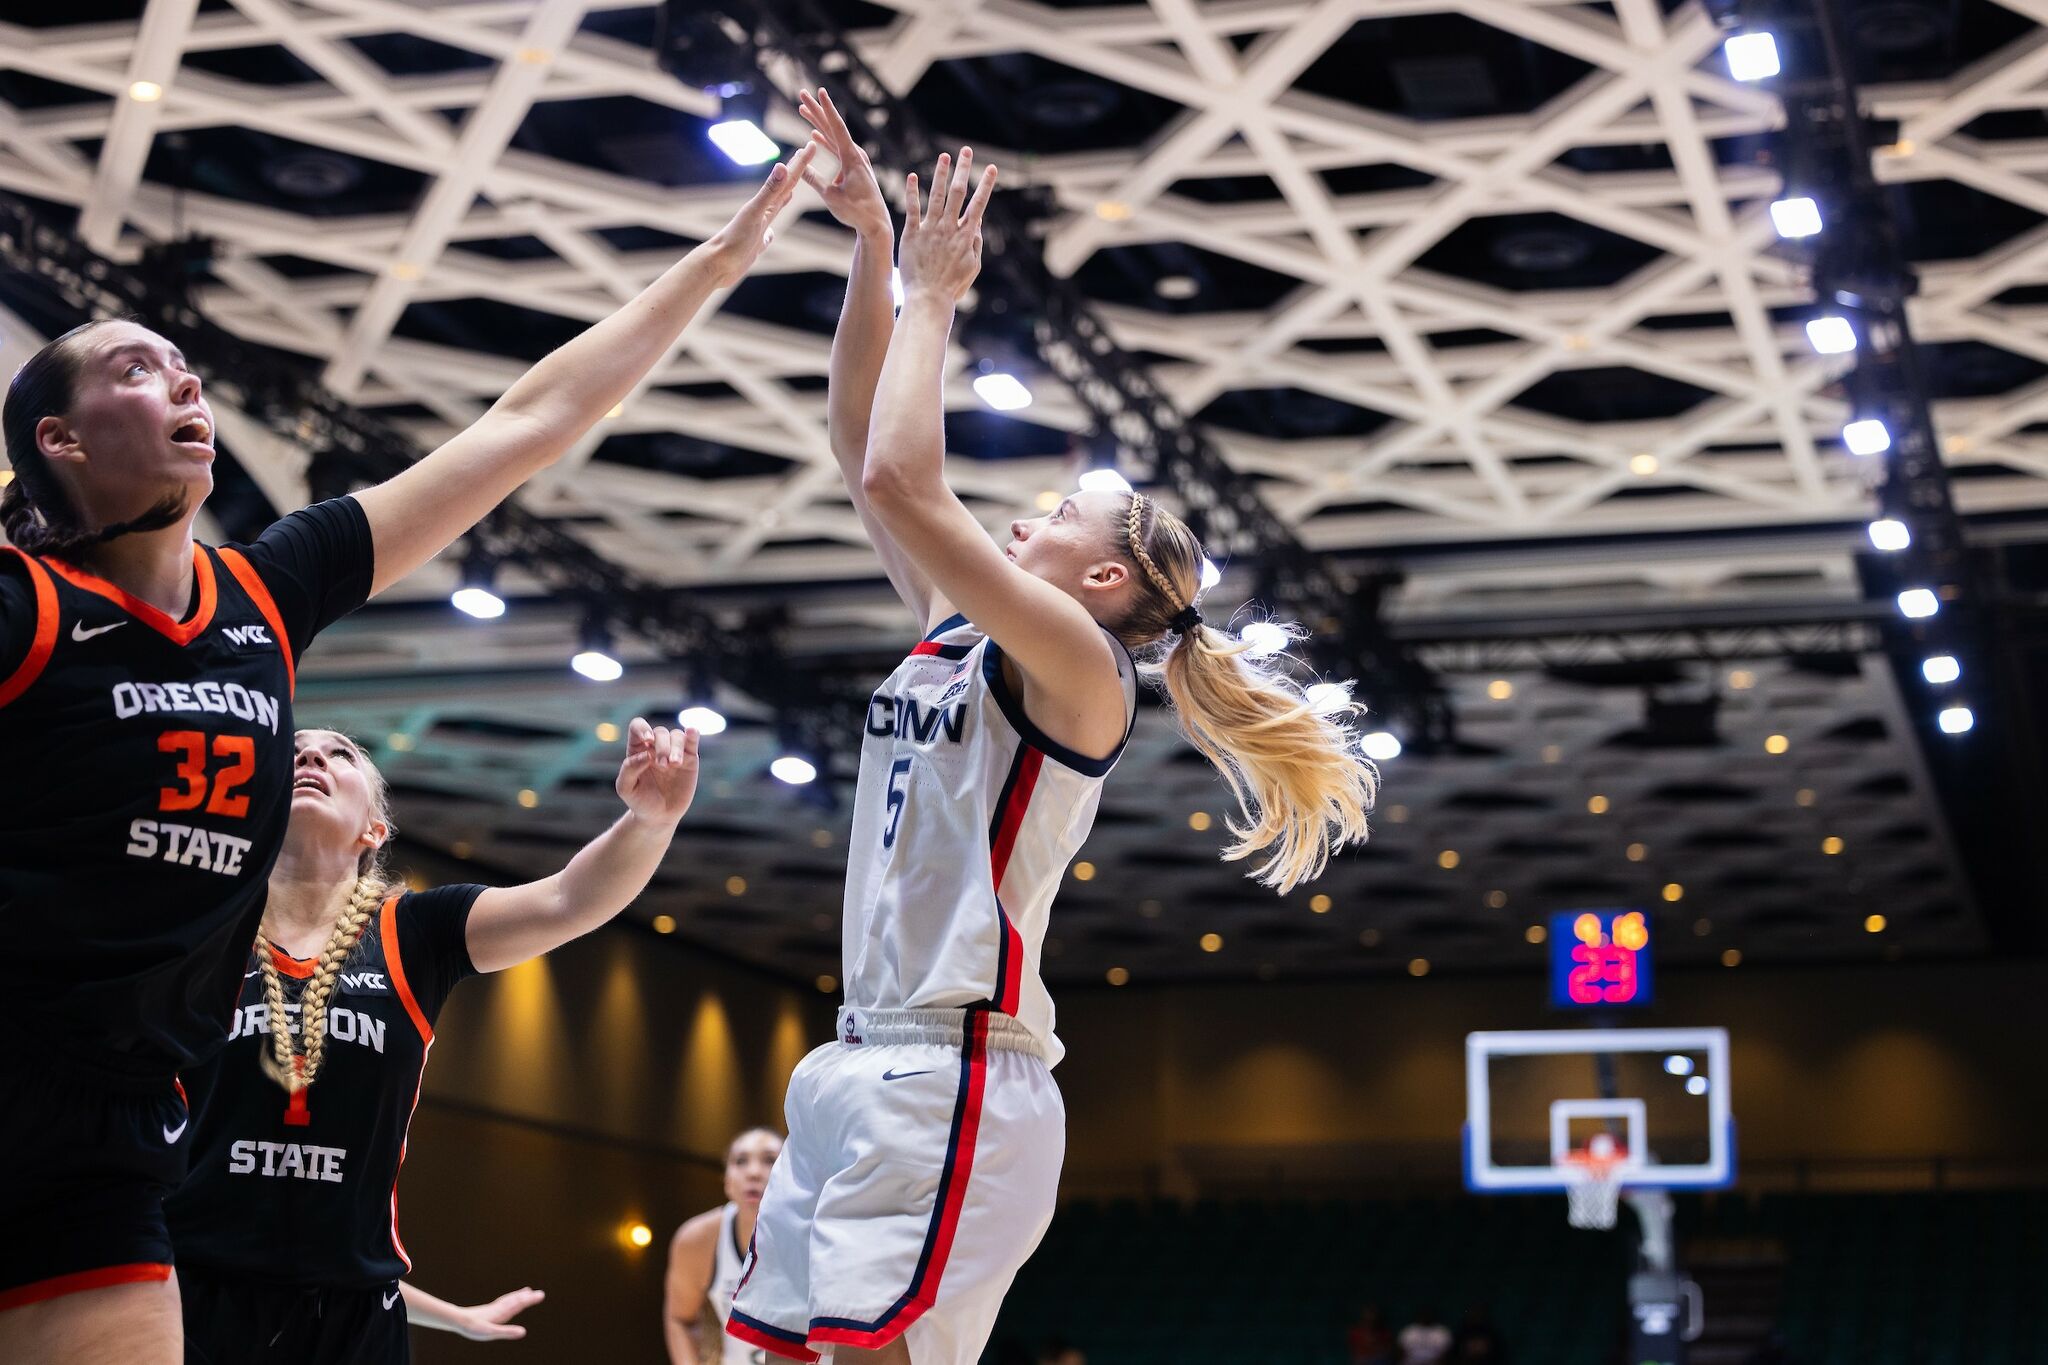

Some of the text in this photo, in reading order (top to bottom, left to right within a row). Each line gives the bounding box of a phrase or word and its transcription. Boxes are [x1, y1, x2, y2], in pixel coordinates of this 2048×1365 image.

[222, 625, 272, 645] WCC
[112, 682, 279, 736] OREGON
[157, 730, 256, 819] 32
[883, 758, 912, 849] 5
[126, 818, 252, 877] STATE
[340, 973, 388, 990] WCC
[1568, 944, 1638, 1004] 23
[229, 1140, 347, 1183] STATE
